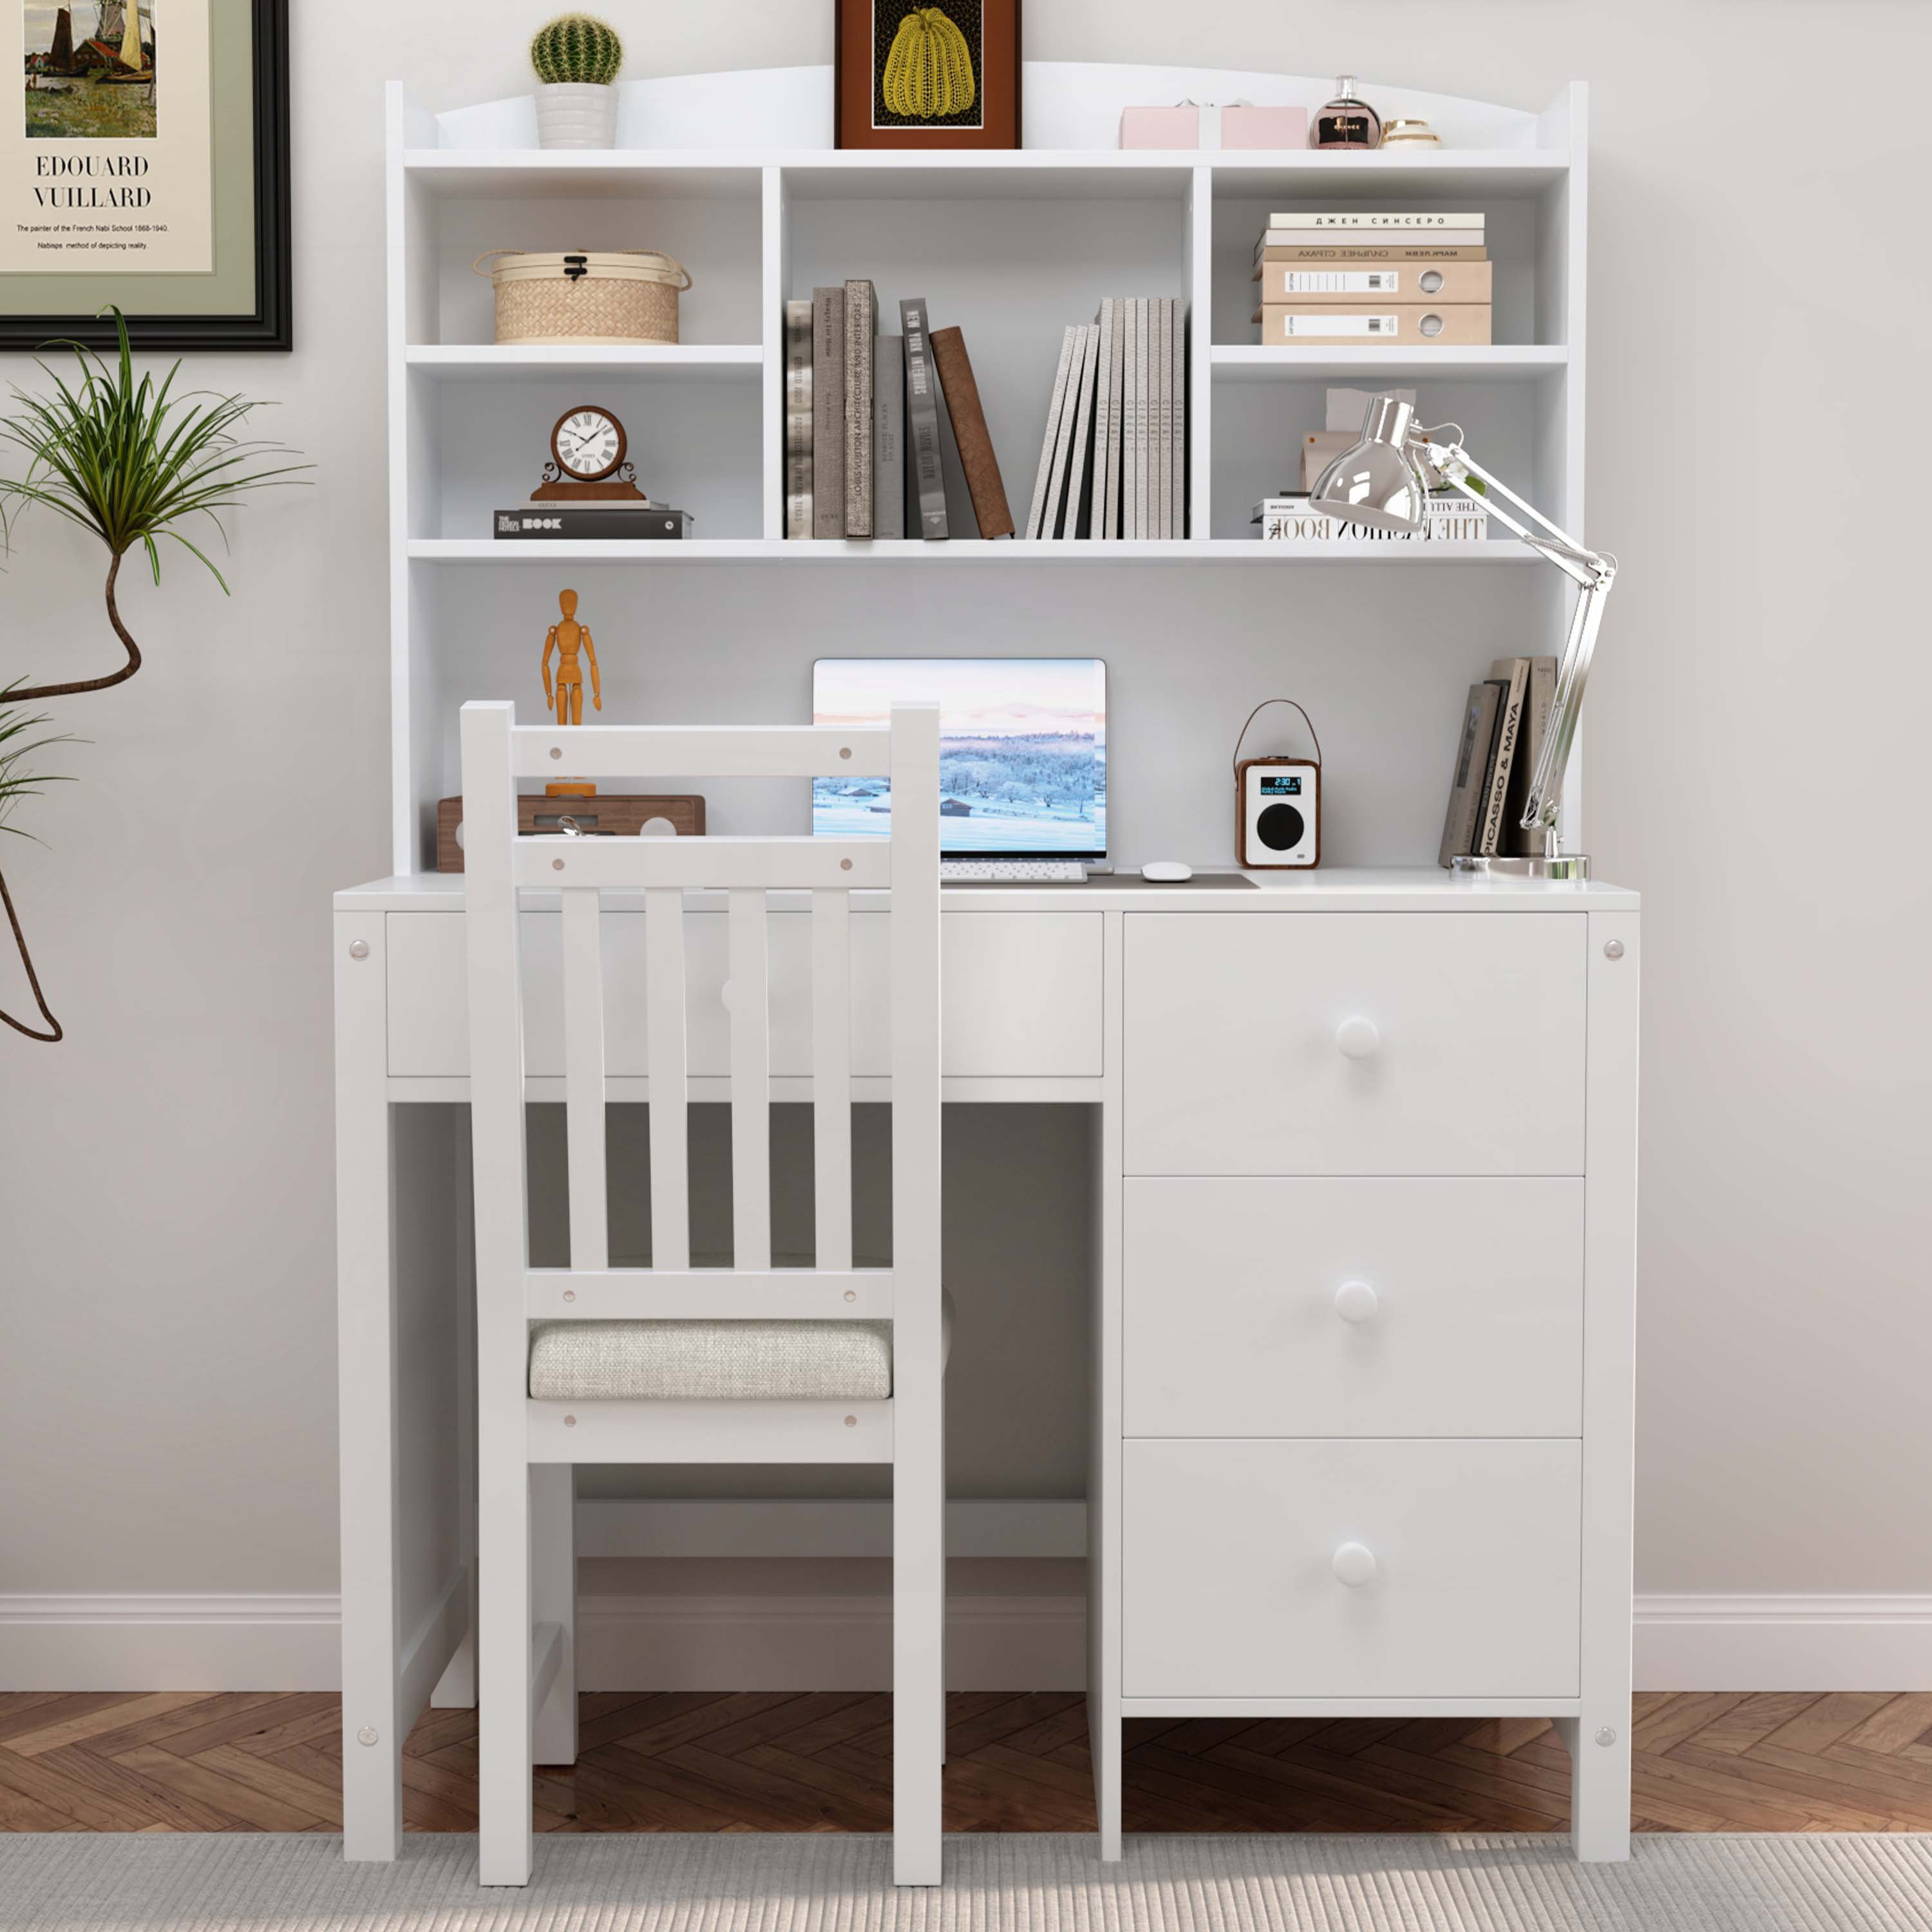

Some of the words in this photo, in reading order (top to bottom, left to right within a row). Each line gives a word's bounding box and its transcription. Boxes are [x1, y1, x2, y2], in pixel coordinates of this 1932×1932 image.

[36, 155, 149, 177] EDOUARD
[33, 187, 151, 208] VUILLARD
[30, 225, 52, 233] painter
[907, 310, 920, 328] NEW
[909, 332, 923, 352] YORK
[911, 355, 927, 395] INTERIORS
[1456, 502, 1478, 512] THE
[522, 518, 562, 529] BOOK
[1504, 703, 1519, 752] MAYA
[1501, 757, 1509, 770] &
[1484, 775, 1505, 855] PICASSO
